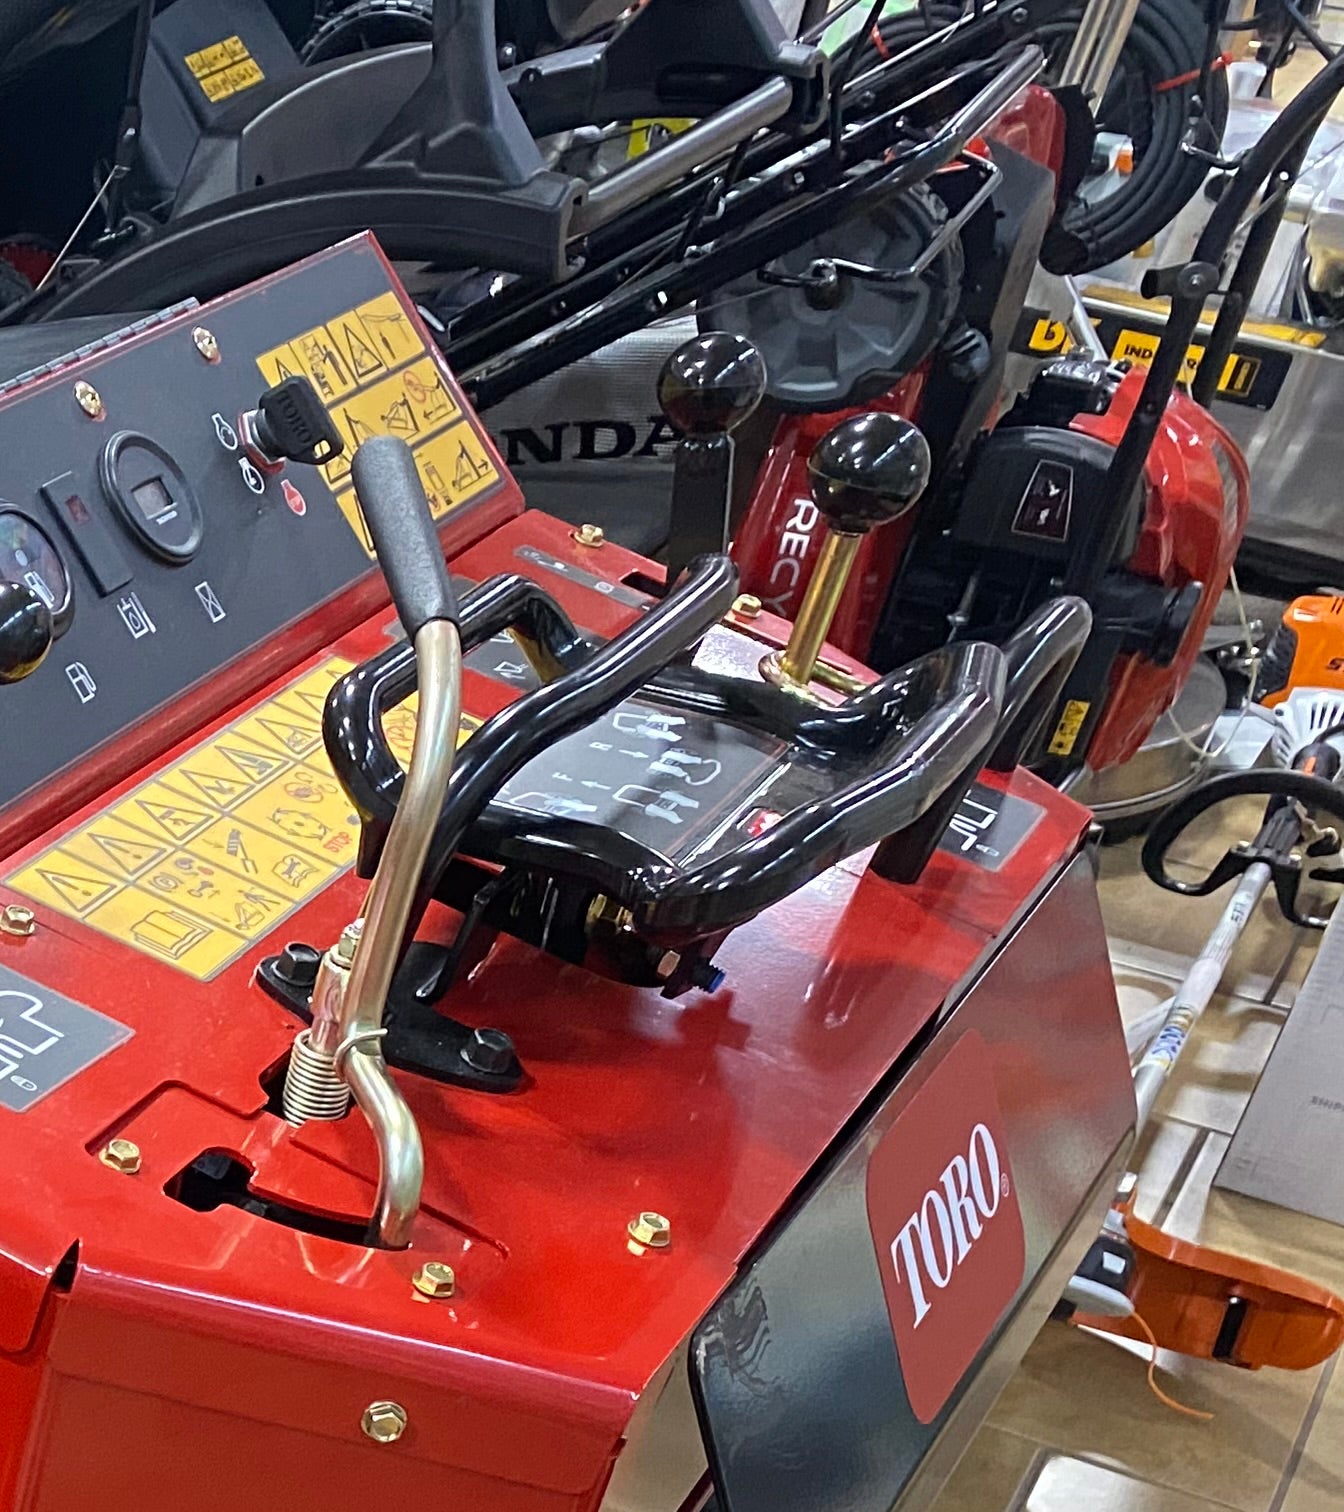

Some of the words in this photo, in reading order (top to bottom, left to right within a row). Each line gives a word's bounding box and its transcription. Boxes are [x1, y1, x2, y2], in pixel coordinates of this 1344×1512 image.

[499, 413, 684, 466] NDA
[762, 498, 820, 617] RECY
[322, 831, 352, 854] STOP
[890, 1123, 1000, 1329] TORO
